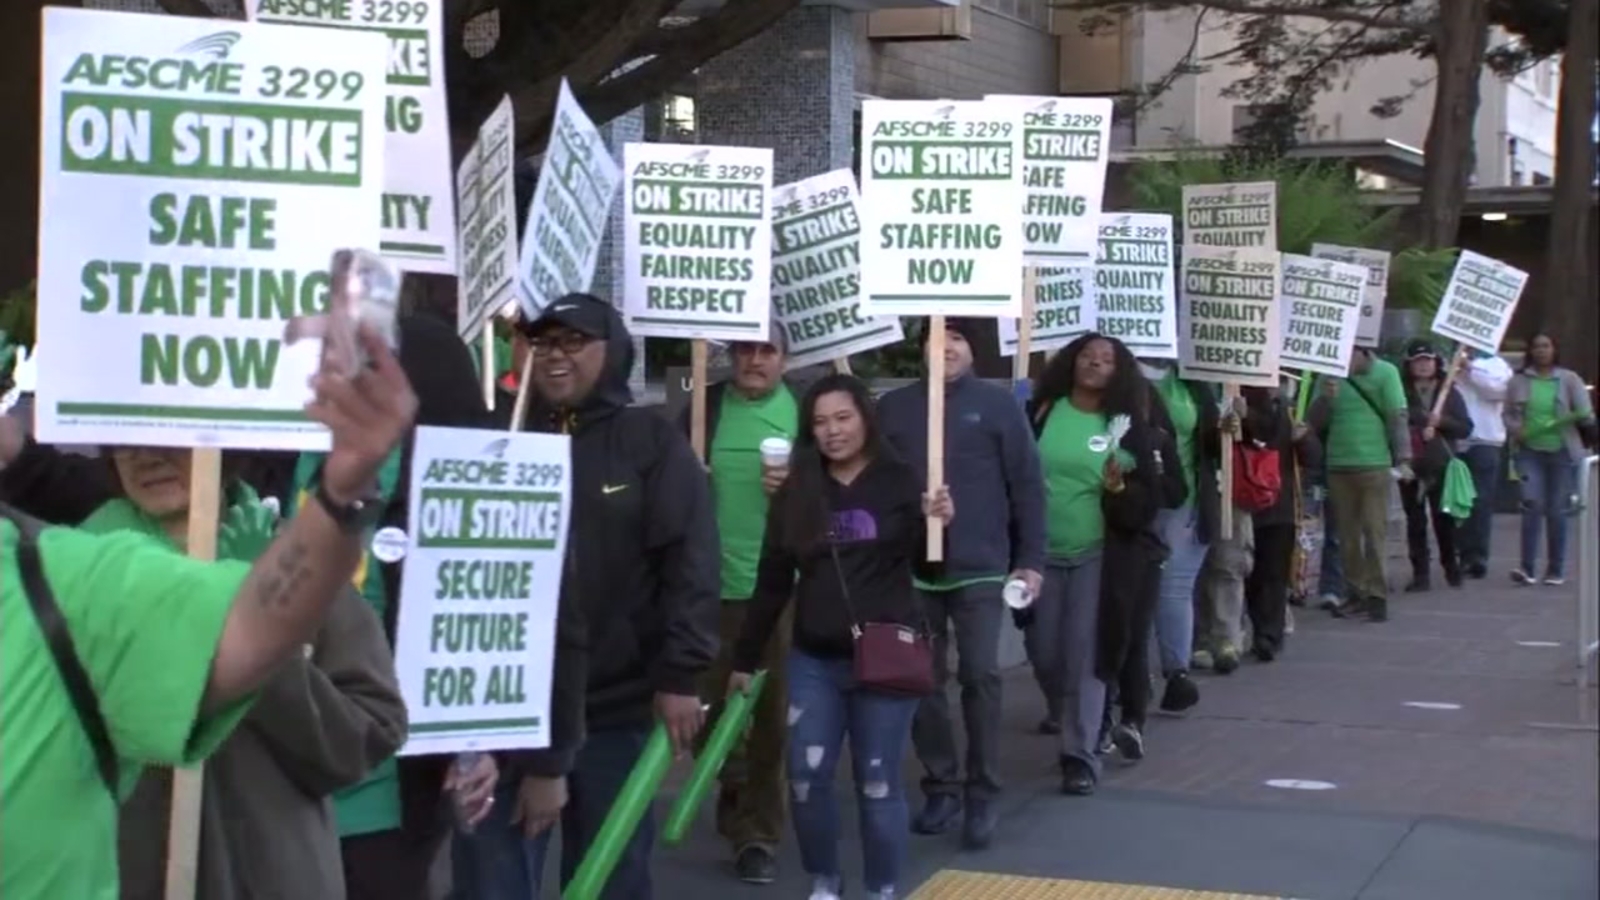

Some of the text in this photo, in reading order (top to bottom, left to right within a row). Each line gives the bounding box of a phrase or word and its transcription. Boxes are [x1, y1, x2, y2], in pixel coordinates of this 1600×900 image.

[257, 0, 429, 24] AFSCME 3299
[62, 53, 364, 101] AFSCME 3299
[872, 120, 1012, 138] AFSCME 3299
[1023, 112, 1103, 127] CME 3299
[67, 105, 151, 162] ON
[172, 112, 357, 174] STRIKE
[1027, 134, 1099, 157] STRIKE
[633, 161, 765, 180] AFSCME 3299
[873, 146, 1011, 175] ON STRIKE
[634, 184, 762, 214] ON STRIKE
[807, 186, 849, 208] 3299
[911, 188, 972, 214] SAFE
[1023, 195, 1086, 216] FFING
[149, 193, 276, 250] SAFE
[783, 206, 860, 248] STRIKE
[1188, 207, 1270, 226] ON STRIKE
[639, 222, 756, 250] EQUALITY
[880, 223, 1002, 250] STAFFING
[1023, 222, 1063, 243] OW
[1135, 226, 1168, 238] 3299
[1193, 230, 1266, 246] EQUALITY
[771, 241, 860, 289] QUALITY
[1112, 243, 1167, 262] STRIKE
[640, 254, 753, 282] FAIRNESS
[907, 259, 974, 285] NOW
[1093, 269, 1164, 290] QUALITY
[80, 260, 331, 320] STAFFING
[771, 271, 860, 317] FAIRNES
[1035, 280, 1083, 304] RNESS
[1187, 274, 1274, 297] ON STRIKE
[1284, 278, 1360, 304] ON STRIKE
[646, 285, 746, 313] RESPECT
[1095, 293, 1165, 313] AIRNESS
[1191, 300, 1268, 322] EQUALITY
[1292, 300, 1345, 322] SECURE
[787, 303, 873, 343] RESPEC
[1015, 305, 1080, 332] SPECT
[1096, 317, 1161, 337] RESPECT
[1288, 319, 1342, 341] FUTURE
[1190, 323, 1267, 344] FAIRNESS
[140, 333, 281, 390] NOW
[1195, 346, 1263, 367] RESPECT
[1283, 337, 1339, 360] FOR ALL
[423, 459, 563, 487] AFSCME 3299
[422, 498, 559, 540] ON STRIKE
[436, 560, 533, 600] SECURE
[431, 612, 528, 653] FUTURE
[423, 665, 526, 707] FOR ALL
